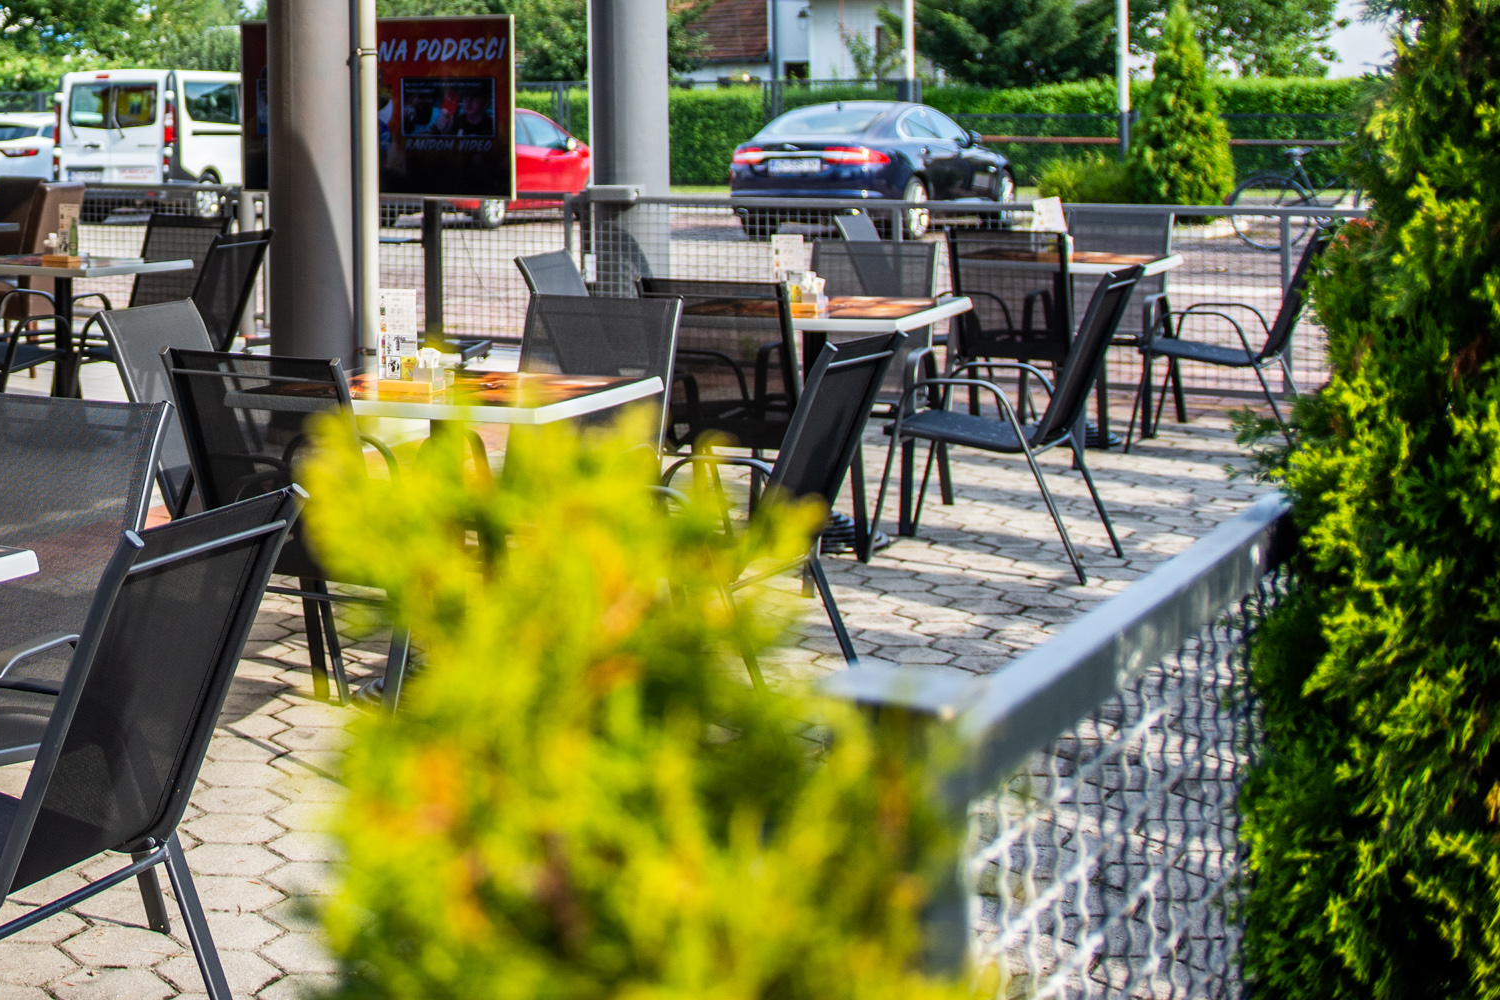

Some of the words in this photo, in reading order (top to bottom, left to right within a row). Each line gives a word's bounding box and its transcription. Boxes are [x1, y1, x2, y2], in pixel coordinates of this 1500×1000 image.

[378, 38, 408, 62] NA
[414, 36, 506, 62] PODRSCI
[406, 138, 454, 151] RANDOM
[459, 139, 492, 152] VIDEO
